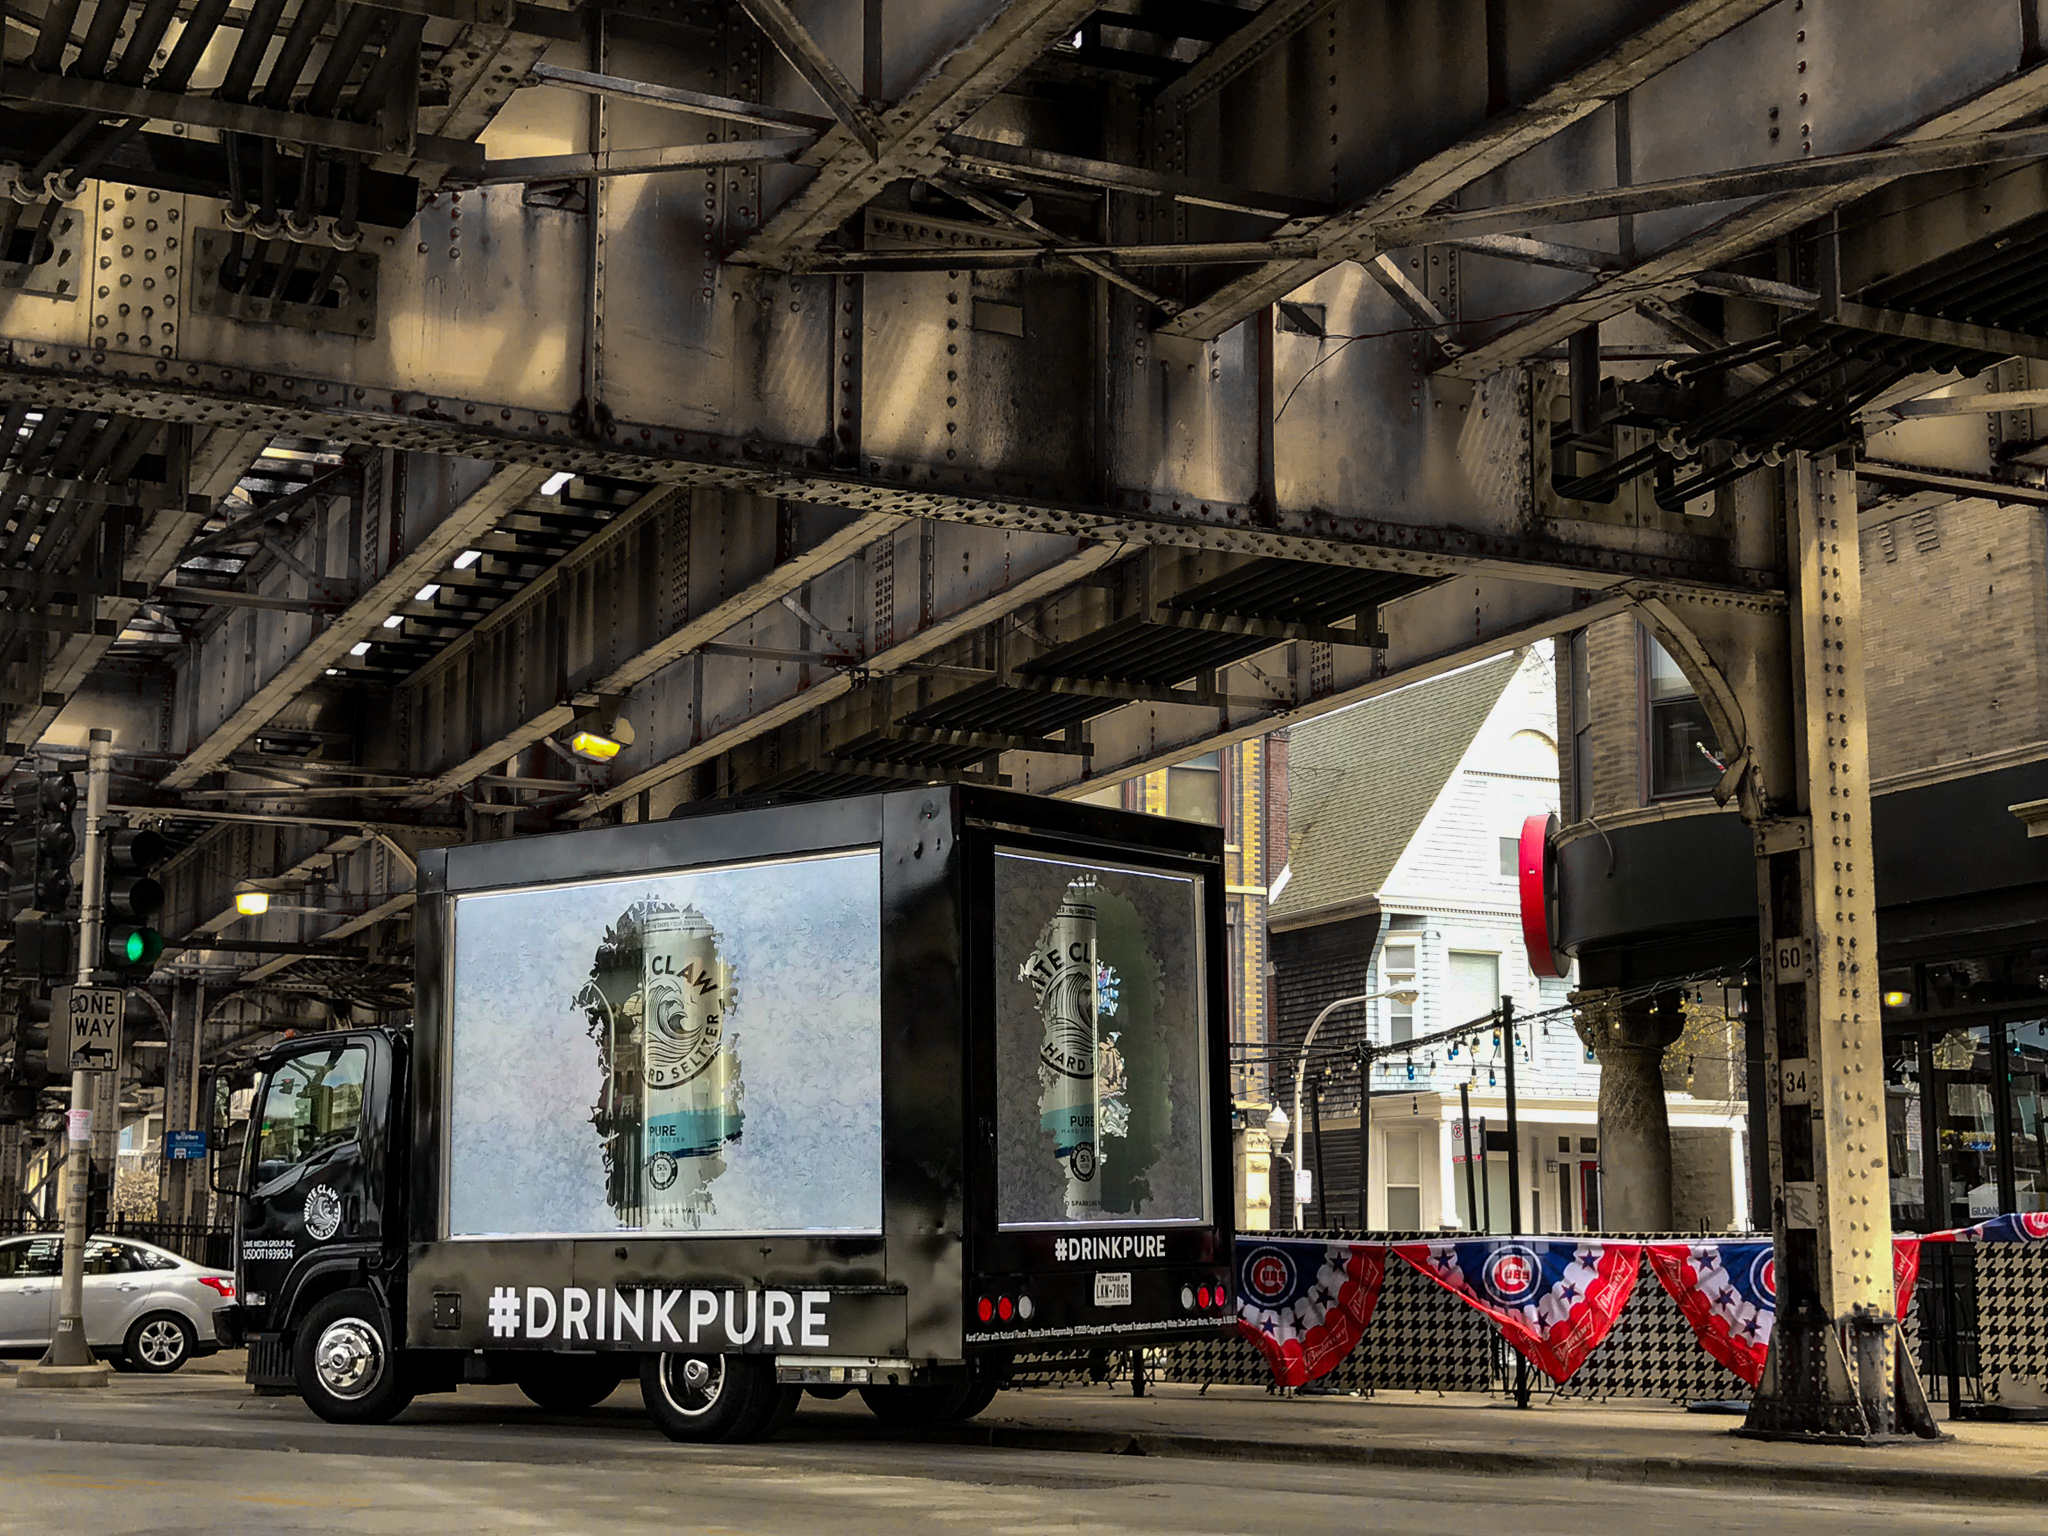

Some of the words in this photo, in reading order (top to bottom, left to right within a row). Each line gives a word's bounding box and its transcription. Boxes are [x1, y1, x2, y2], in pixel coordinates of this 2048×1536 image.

[1033, 949, 1065, 993] ITE
[1069, 942, 1092, 963] CL
[1779, 947, 1800, 969] 60
[651, 955, 718, 995] CLAW
[77, 994, 115, 1014] ONE
[75, 1017, 115, 1037] WAY
[648, 1068, 664, 1082] RD
[671, 1014, 719, 1079] SELTZER
[1043, 1042, 1085, 1071] HARD
[1785, 1071, 1806, 1093] 34
[650, 1125, 677, 1137] PURE
[1070, 1116, 1094, 1127] PURE
[304, 1188, 317, 1222] WHITE
[317, 1184, 339, 1201] CLAW
[1055, 1235, 1166, 1261] #DRINKPURE
[488, 1287, 831, 1347] #DRINKPURE
